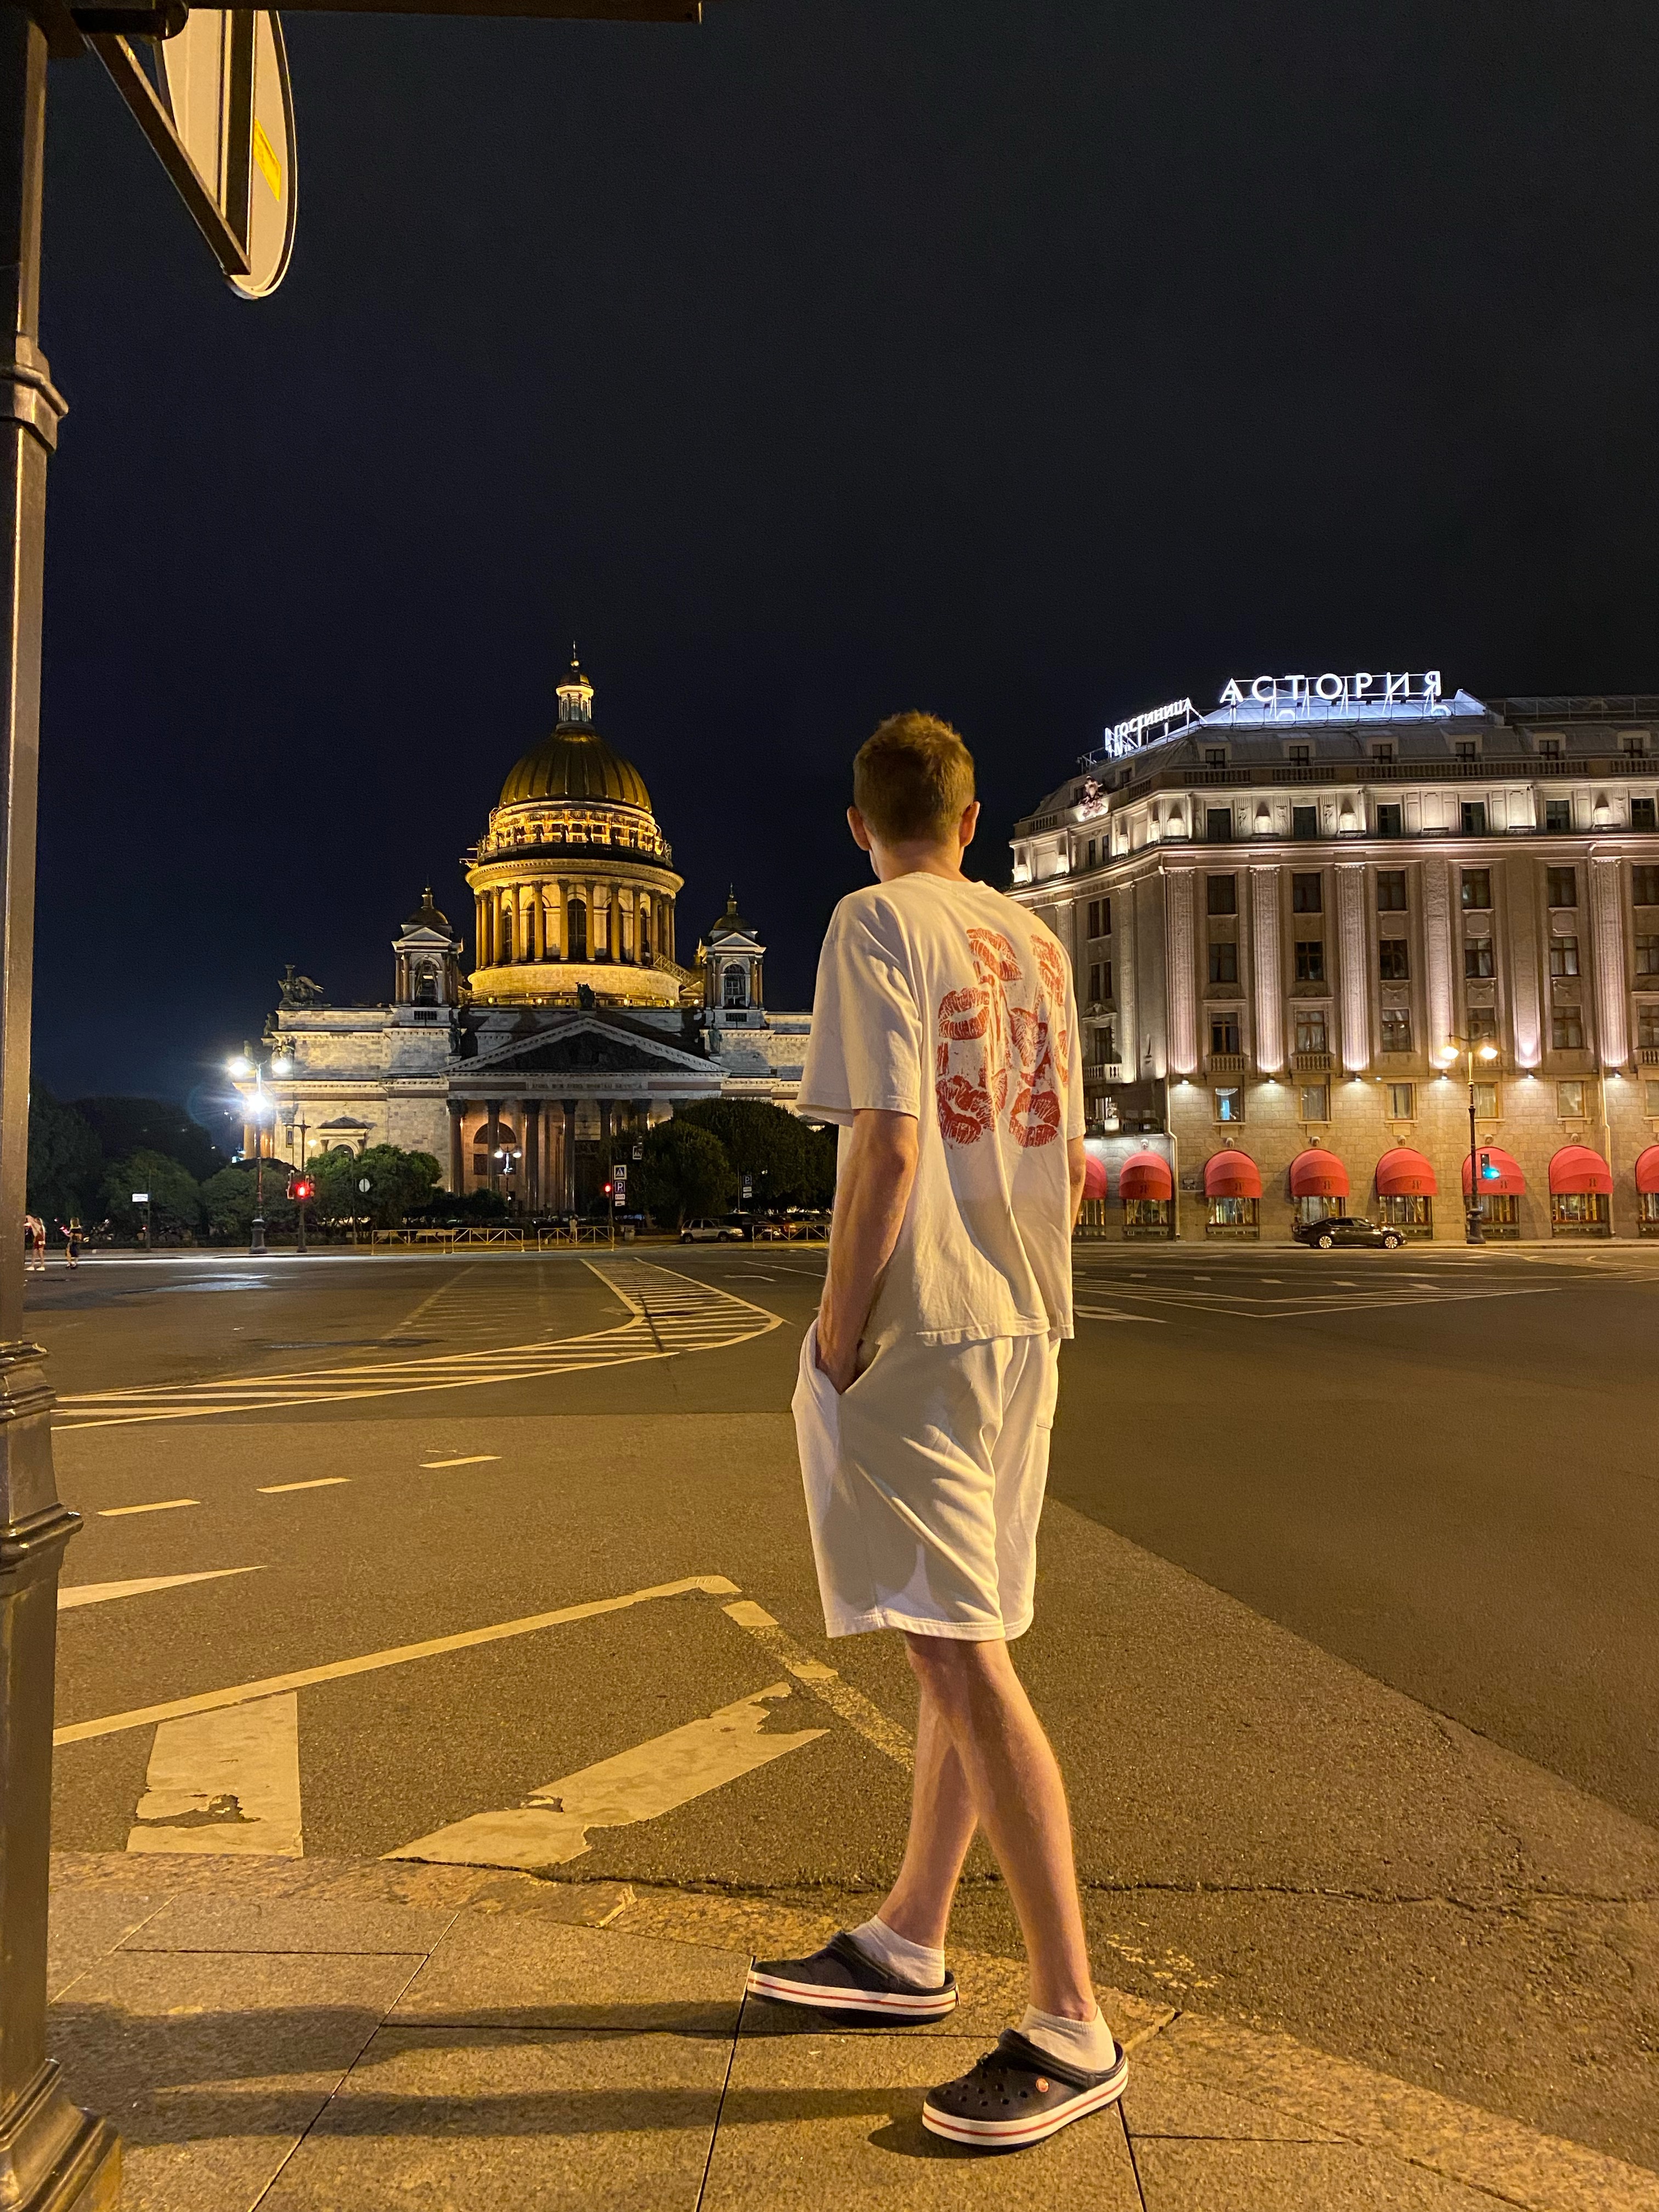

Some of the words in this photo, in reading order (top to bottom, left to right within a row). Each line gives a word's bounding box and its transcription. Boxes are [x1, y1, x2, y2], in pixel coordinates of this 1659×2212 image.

[1220, 671, 1441, 703] АСТОРИЯ
[1114, 697, 1192, 738] ГОСТИНИЦА
[617, 1183, 623, 1192] P
